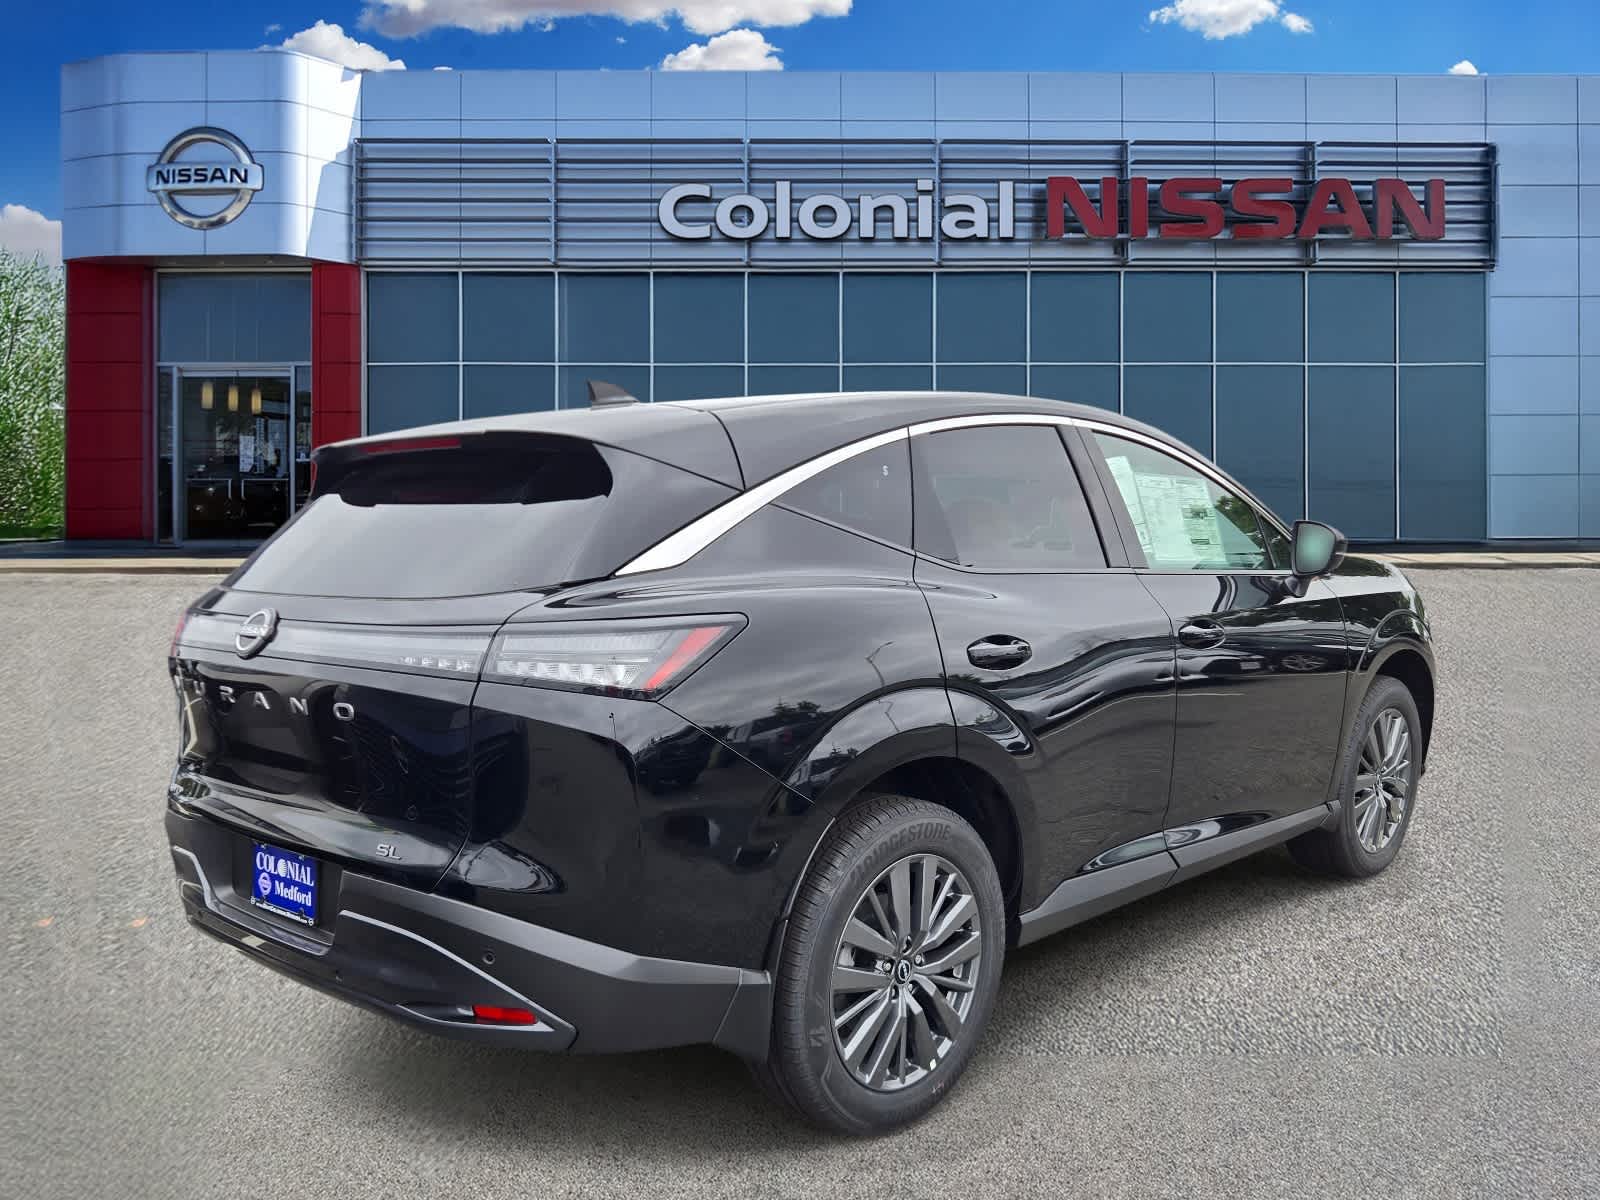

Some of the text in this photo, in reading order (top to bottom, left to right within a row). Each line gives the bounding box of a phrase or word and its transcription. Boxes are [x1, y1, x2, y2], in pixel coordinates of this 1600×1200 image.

[155, 167, 249, 186] NISSAN
[658, 175, 1446, 241] Colonial NISSAN
[375, 843, 402, 860] SL
[274, 879, 312, 907] Medford
